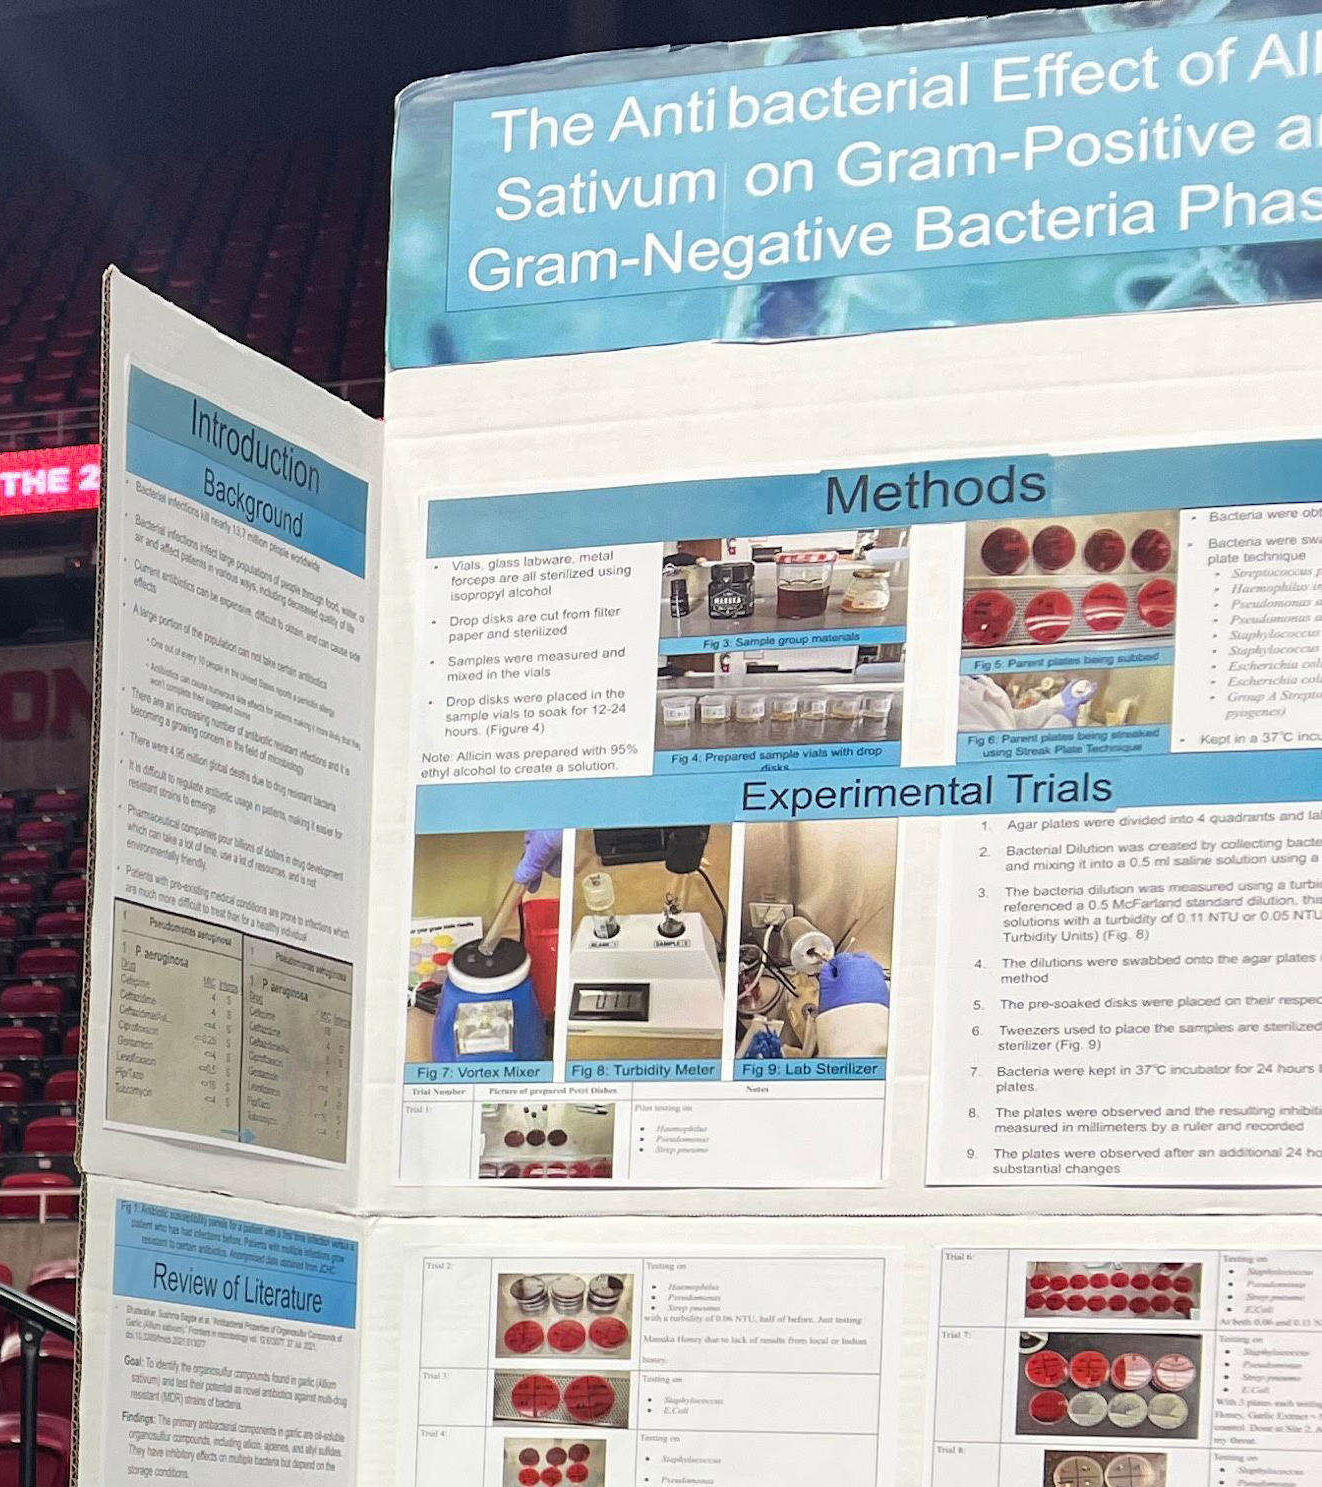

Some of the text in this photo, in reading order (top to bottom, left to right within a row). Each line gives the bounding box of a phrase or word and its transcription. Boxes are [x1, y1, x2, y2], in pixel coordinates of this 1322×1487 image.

[491, 107, 594, 152] The
[994, 46, 1159, 102] Effect
[1179, 36, 1238, 86] of
[496, 114, 1322, 221] Sativum on Gram-Positive a
[469, 217, 893, 293] Gram-Negative
[916, 191, 1155, 251] Bacteria
[192, 398, 320, 494] Introduction
[0, 468, 69, 496] THE
[204, 468, 303, 538] Background
[826, 462, 1046, 515] Methods
[743, 772, 1112, 815] Experimental Trials
[417, 1067, 437, 1081] Fig
[458, 1067, 499, 1078] Vortex
[504, 1066, 540, 1077] Mixer
[154, 1262, 322, 1314] Review of Literature
